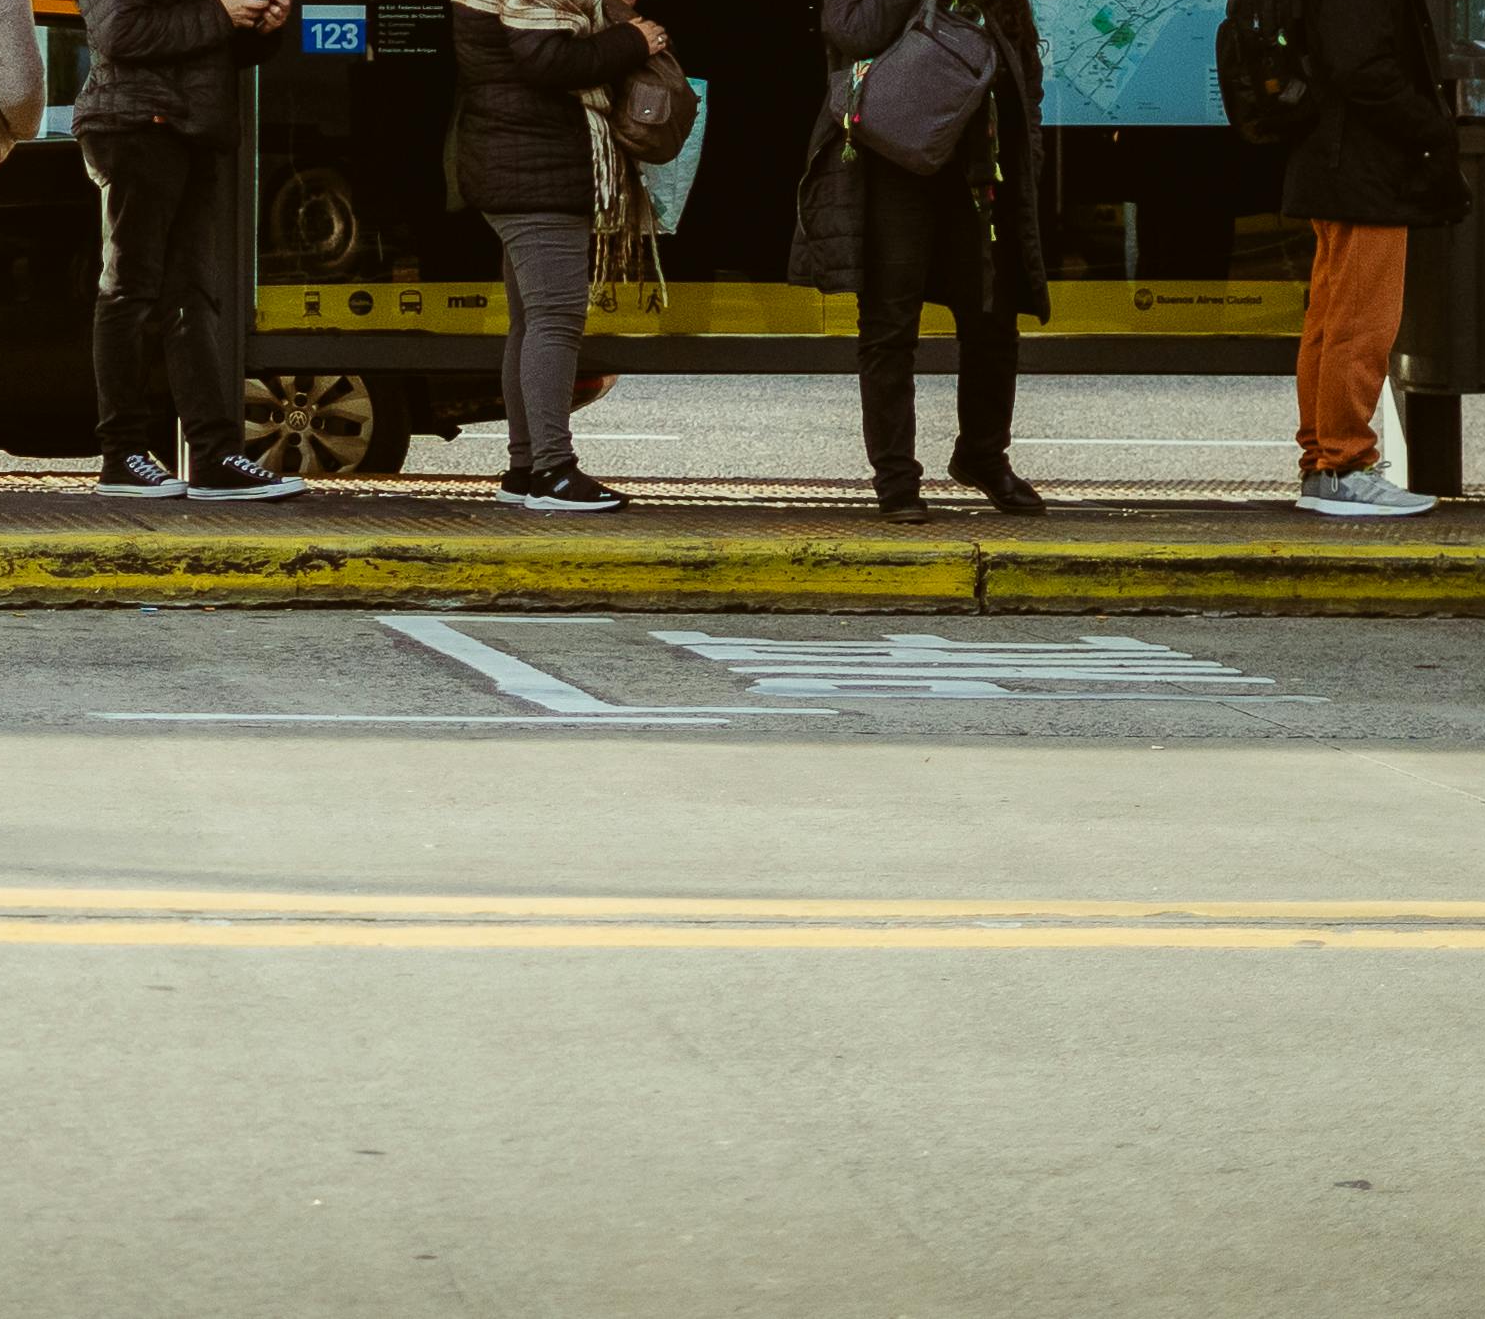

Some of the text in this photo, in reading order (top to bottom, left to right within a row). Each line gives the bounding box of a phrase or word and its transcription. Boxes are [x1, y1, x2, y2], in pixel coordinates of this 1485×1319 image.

[310, 23, 359, 50] 123
[1157, 295, 1263, 304] Buenos Aires Ciudad
